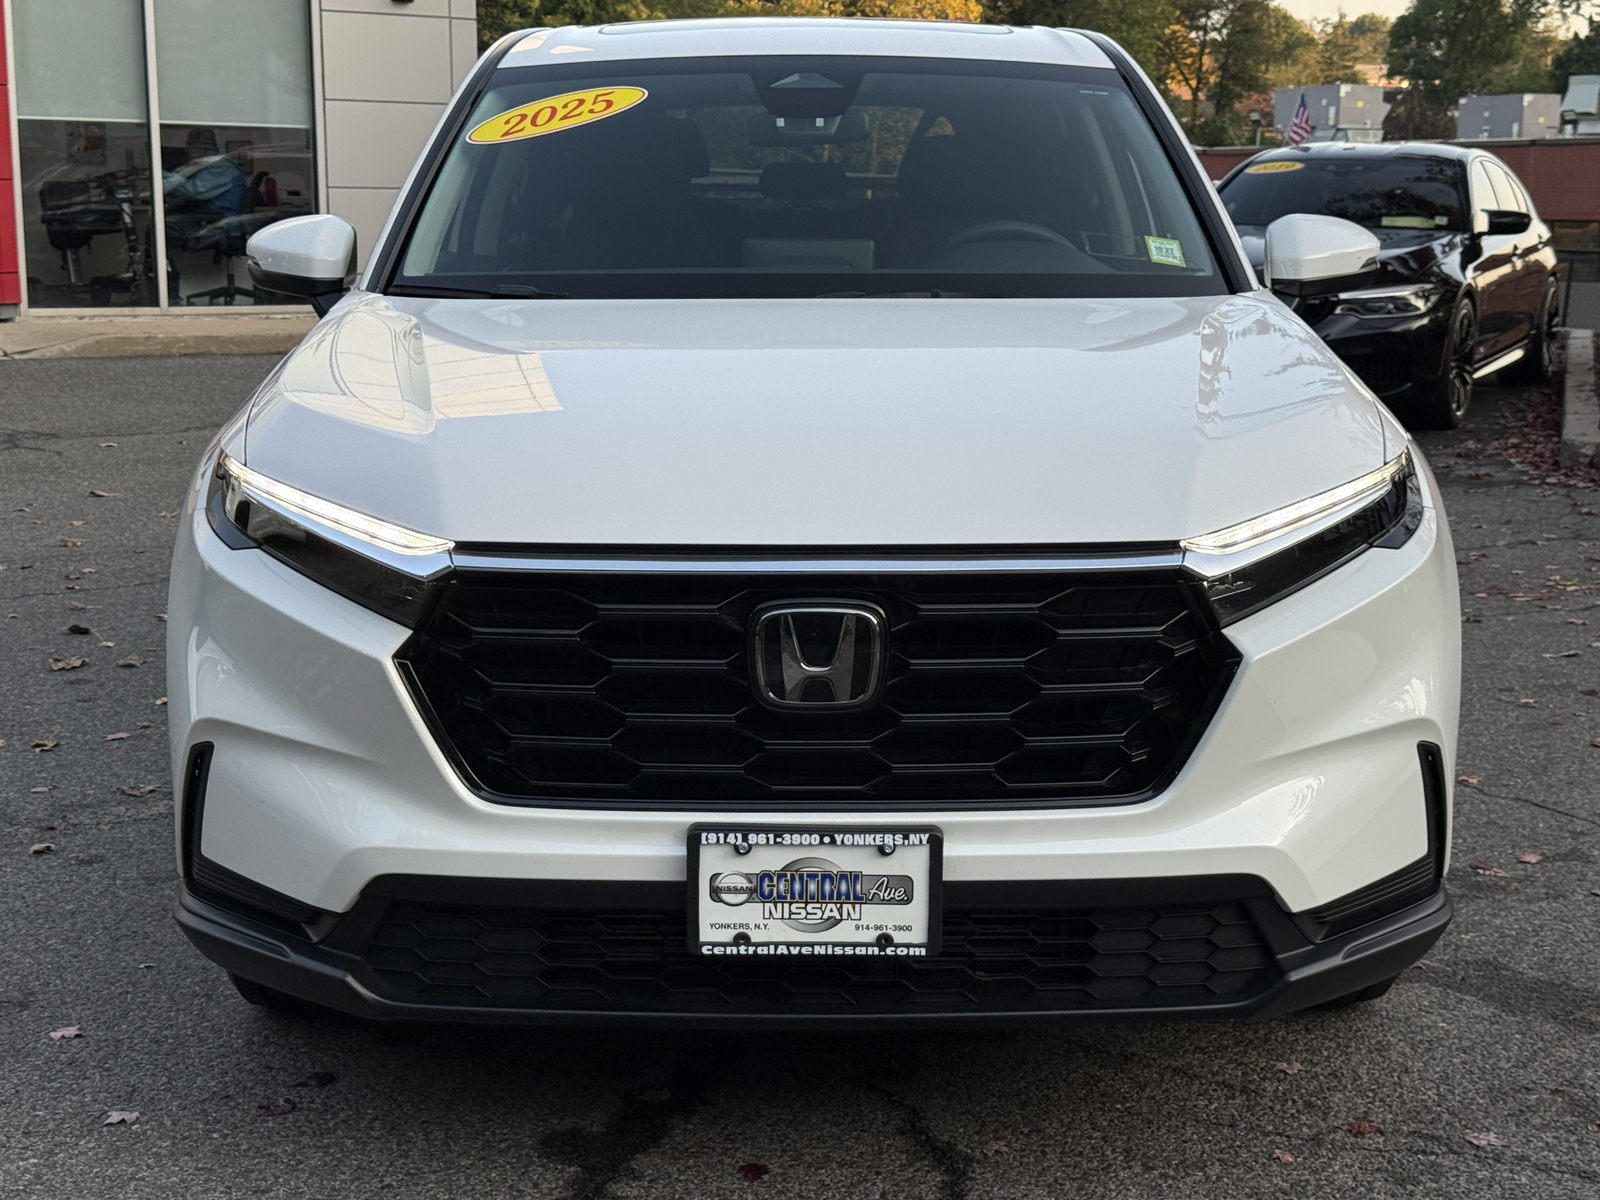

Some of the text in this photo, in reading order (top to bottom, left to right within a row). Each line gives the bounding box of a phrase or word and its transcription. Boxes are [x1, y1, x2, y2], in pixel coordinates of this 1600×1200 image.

[500, 91, 616, 138] 2025
[747, 833, 820, 845] 961-3900
[834, 834, 929, 846] YONKERS,NY
[757, 870, 908, 903] CENTRAL Ave.
[763, 902, 862, 920] NISSAN
[709, 922, 770, 931] YONKERS, N.Y.
[854, 924, 913, 932] 914-961-3900
[701, 944, 926, 956] CentralAveNissan.com
